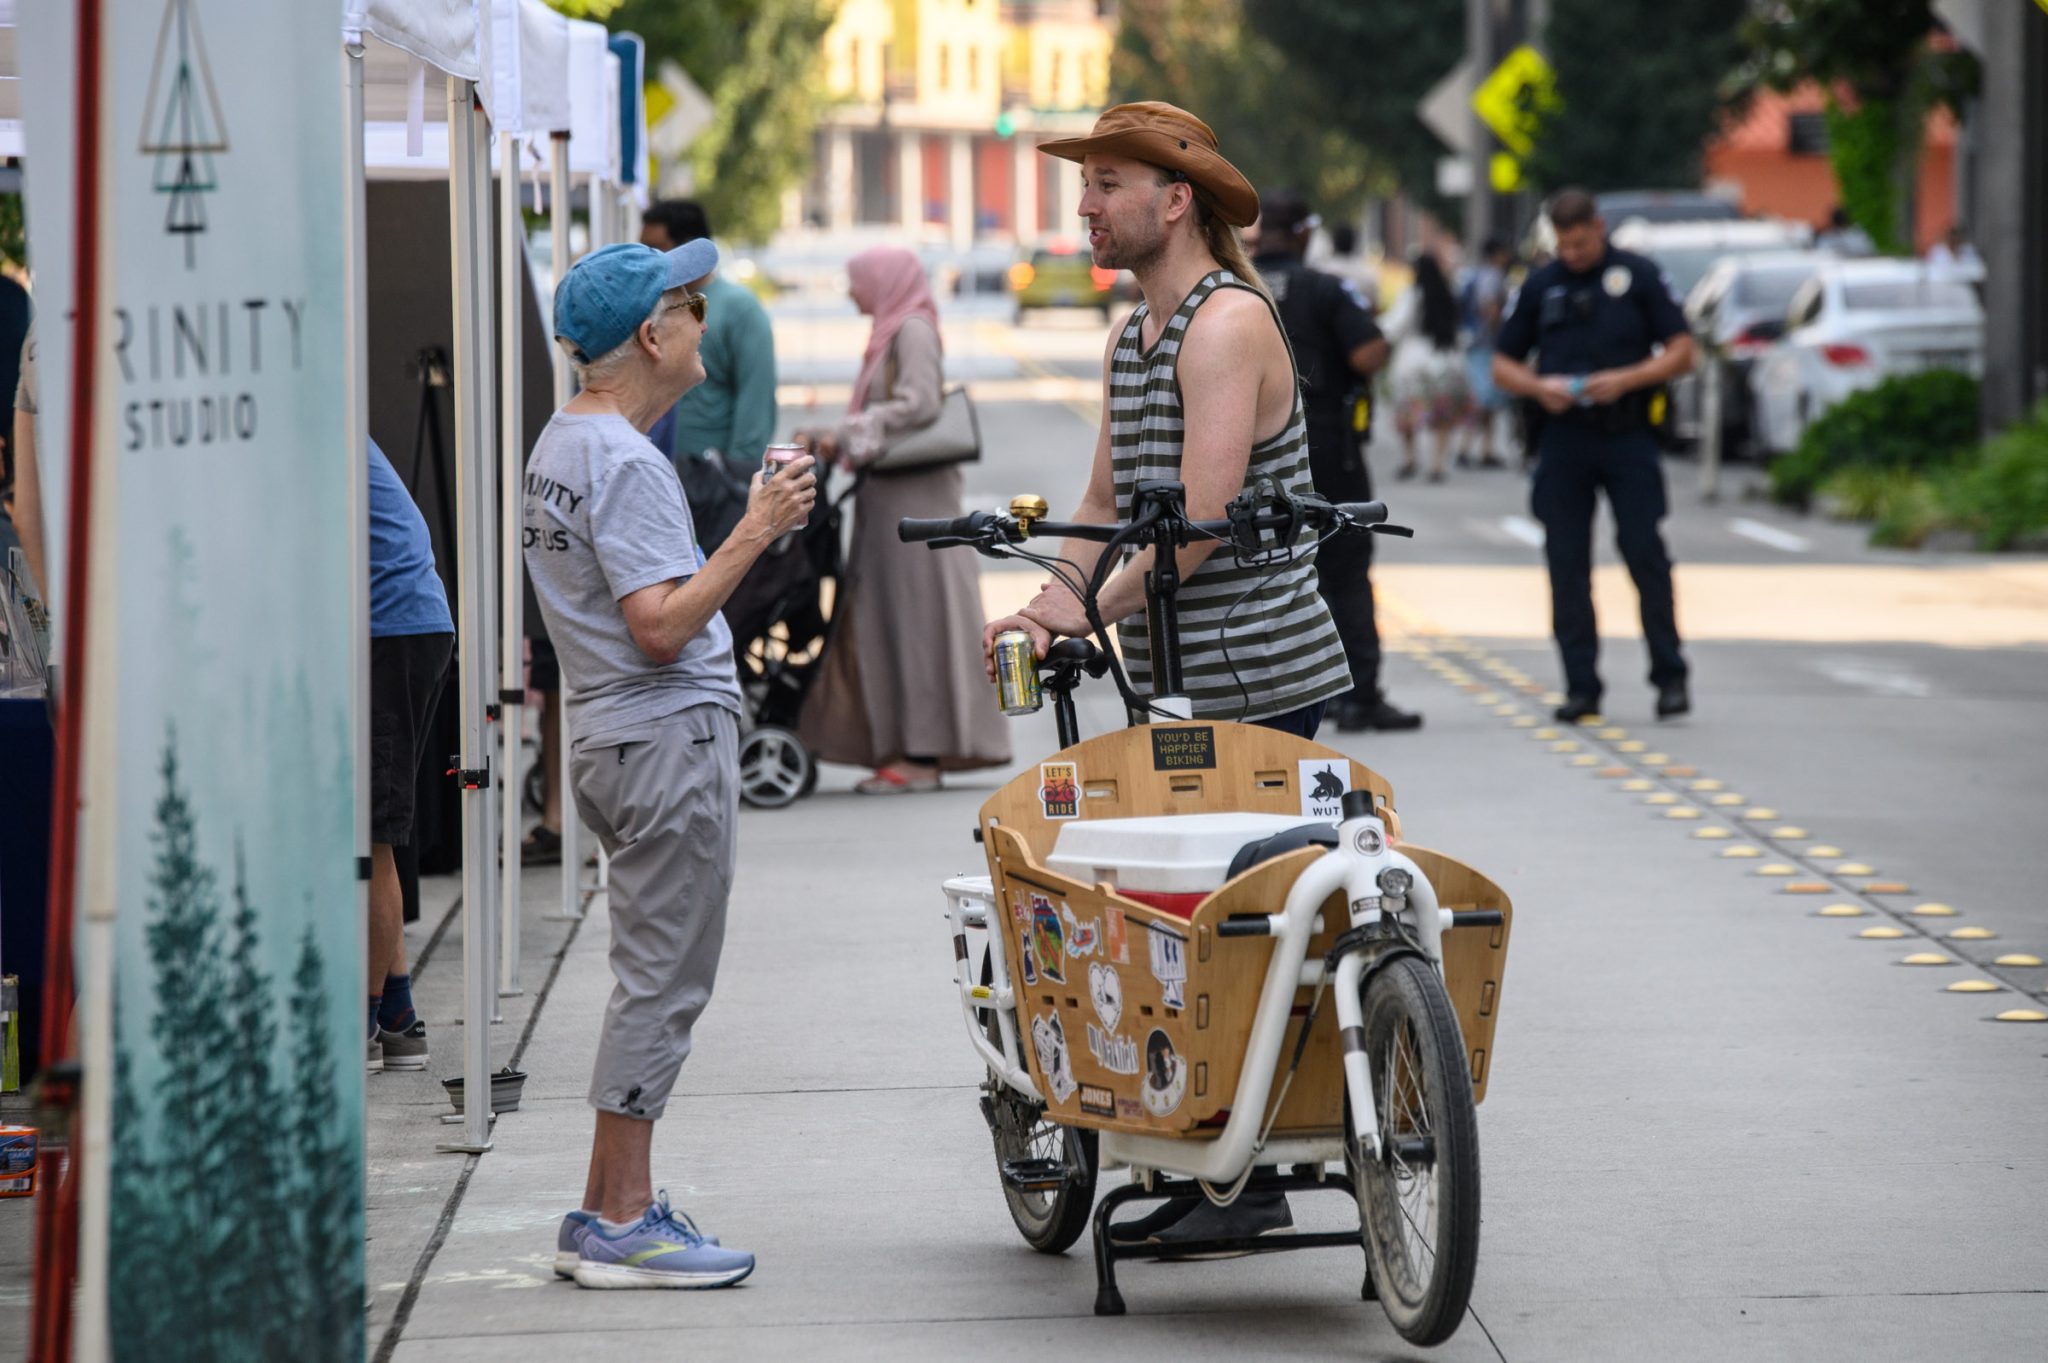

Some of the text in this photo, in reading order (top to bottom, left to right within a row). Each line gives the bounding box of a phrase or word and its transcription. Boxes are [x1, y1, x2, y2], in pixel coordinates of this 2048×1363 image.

[112, 298, 307, 384] RINITY
[124, 391, 259, 451] STUDIO
[542, 529, 569, 552] US
[1156, 731, 1209, 743] YOU'D BE
[1160, 743, 1208, 754] HAPPIER
[1165, 755, 1205, 766] BIKING
[1045, 767, 1072, 778] LET'S
[1048, 803, 1074, 815] RIDE
[1312, 806, 1340, 817] WUT
[1080, 1086, 1113, 1108] JONES
